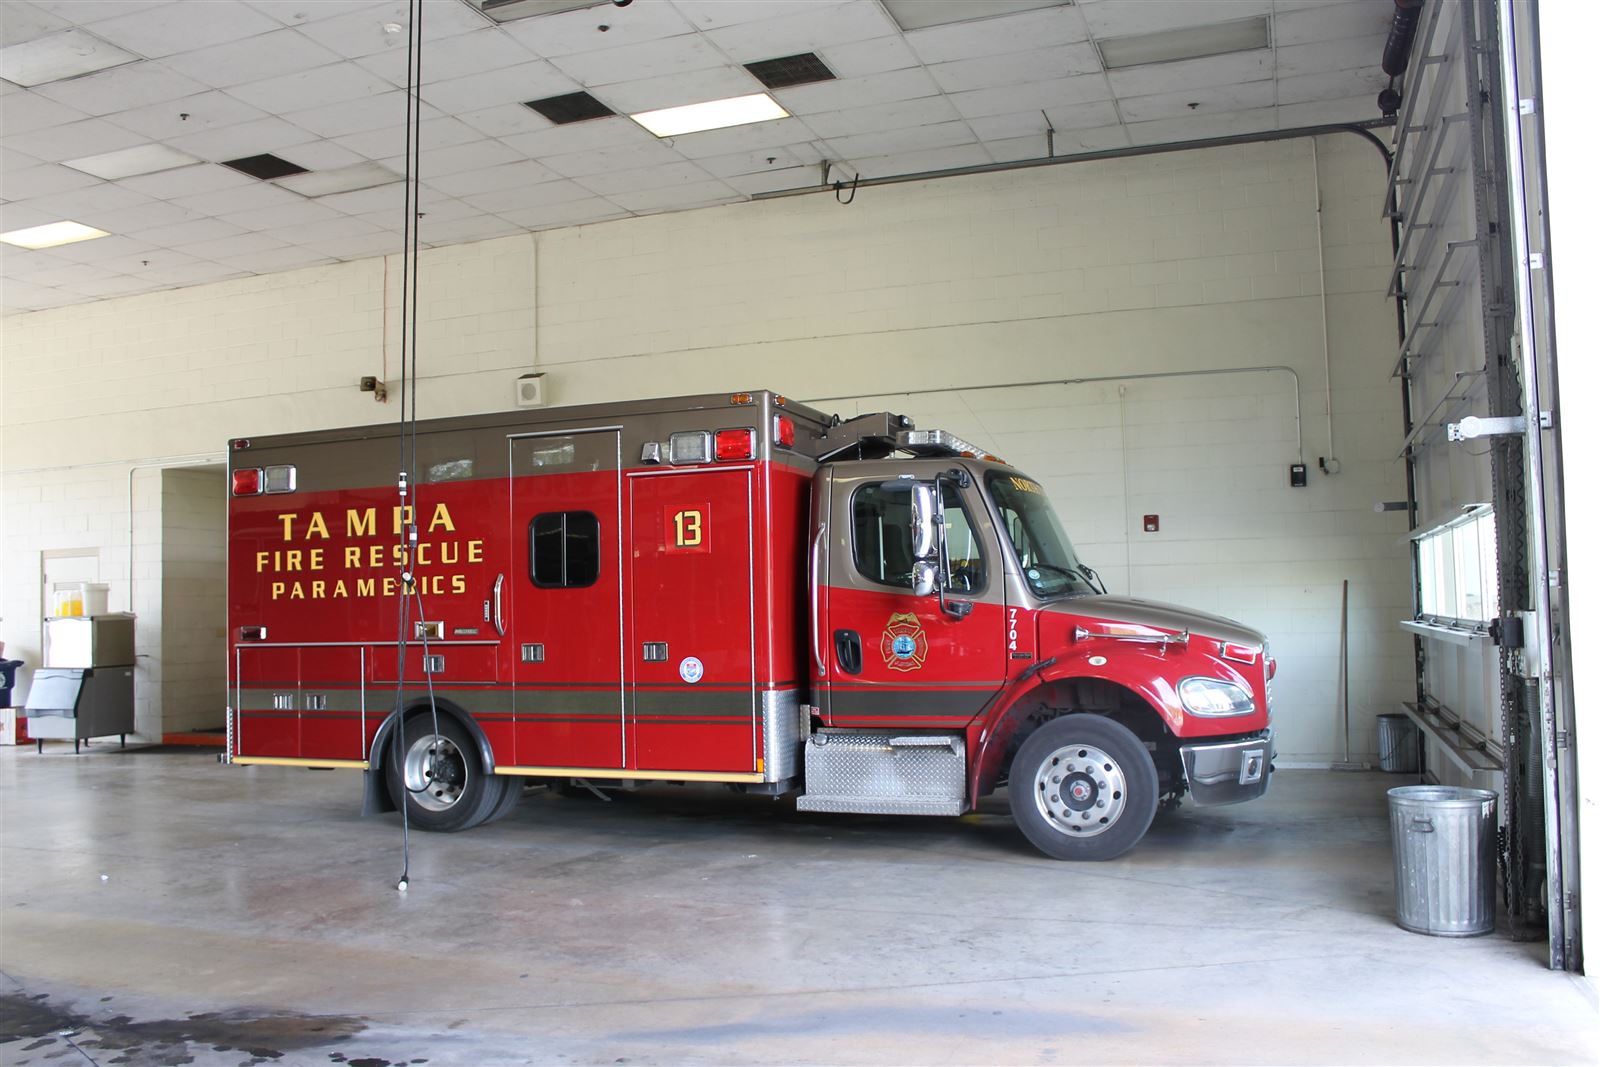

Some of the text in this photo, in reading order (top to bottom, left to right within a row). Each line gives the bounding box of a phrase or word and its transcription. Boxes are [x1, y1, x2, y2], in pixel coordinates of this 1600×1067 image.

[278, 503, 456, 541] TAMPA
[674, 510, 702, 546] 13
[256, 540, 484, 573] FIRE RESCUE
[1009, 608, 1017, 651] 7704
